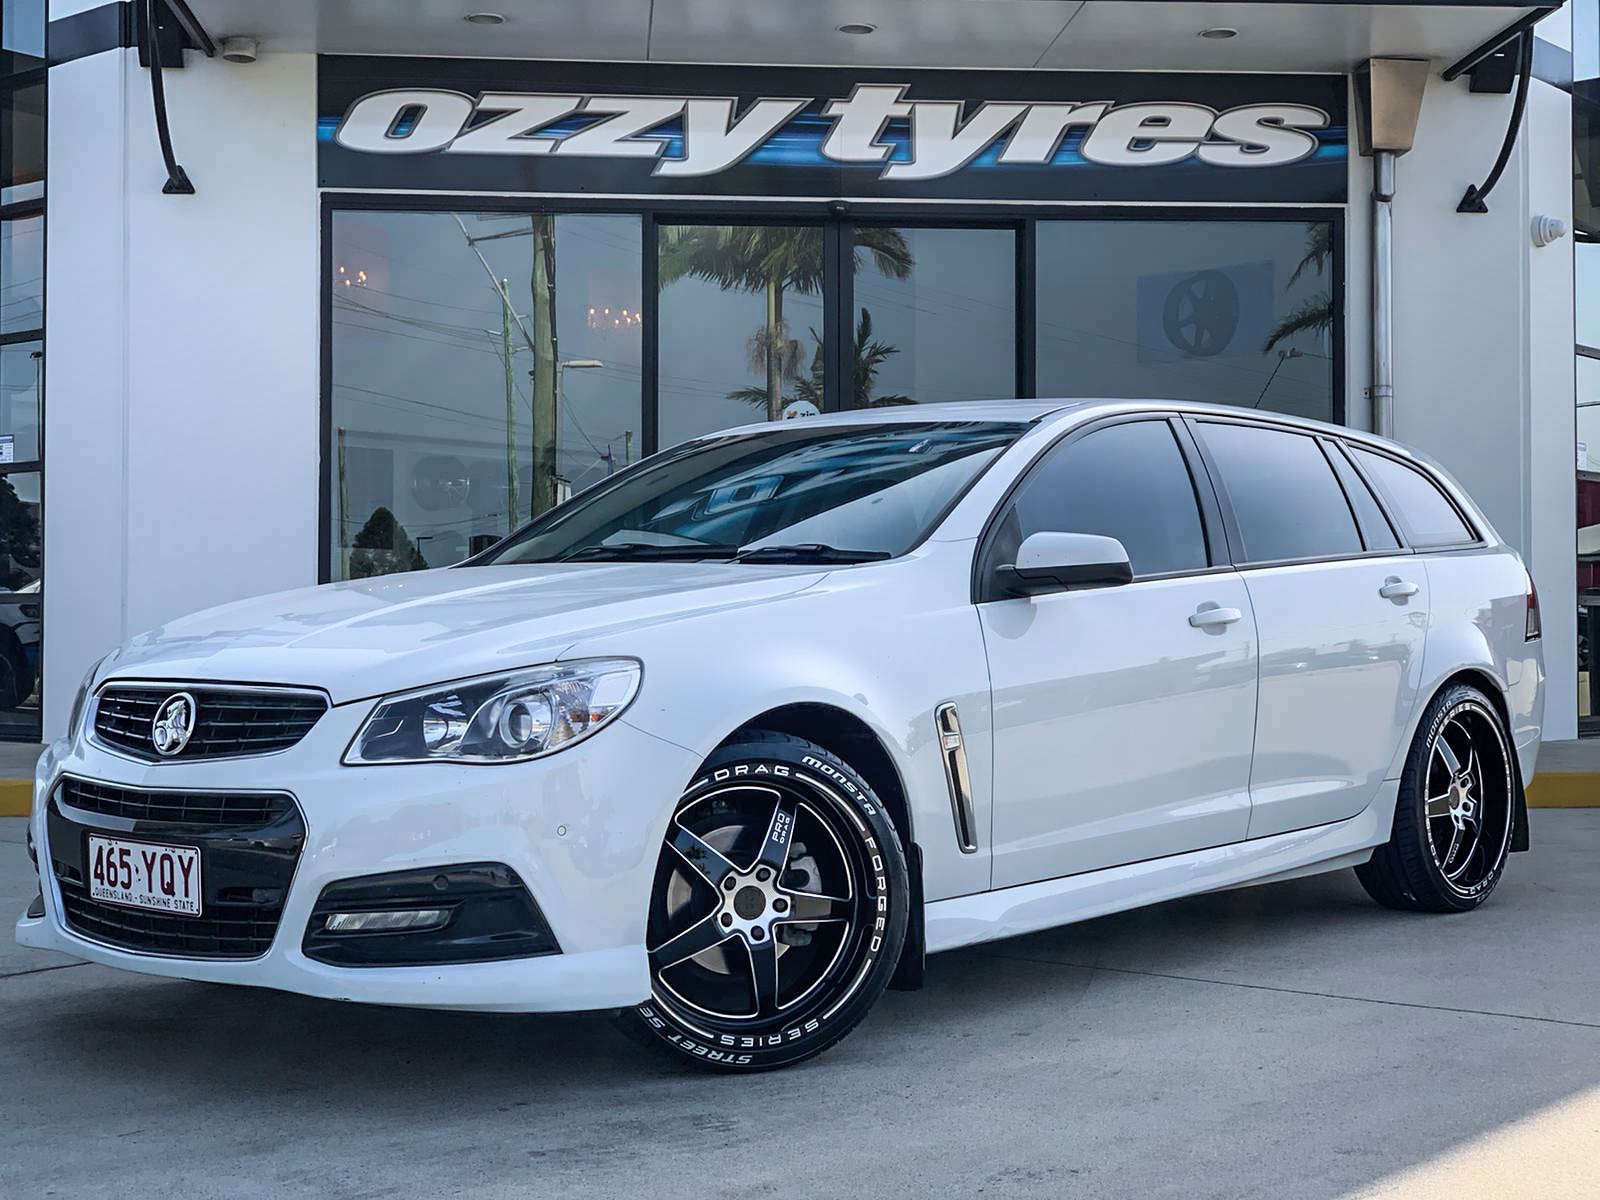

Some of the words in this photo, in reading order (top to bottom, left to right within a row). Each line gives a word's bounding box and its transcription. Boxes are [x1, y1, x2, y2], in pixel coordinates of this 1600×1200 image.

[335, 88, 814, 177] ozzy
[820, 83, 1330, 180] tyres
[714, 764, 790, 781] DRAG
[772, 812, 786, 844] PRO
[779, 817, 791, 844] DRAG
[94, 845, 132, 890] 465
[141, 850, 194, 898] YQY
[94, 887, 133, 902] QUEENSLAND
[139, 894, 171, 909] SUNSHINE
[174, 900, 194, 912] STATE
[864, 837, 887, 952] FORGED
[667, 1034, 753, 1064] STREET
[721, 1021, 820, 1047] SERIES
